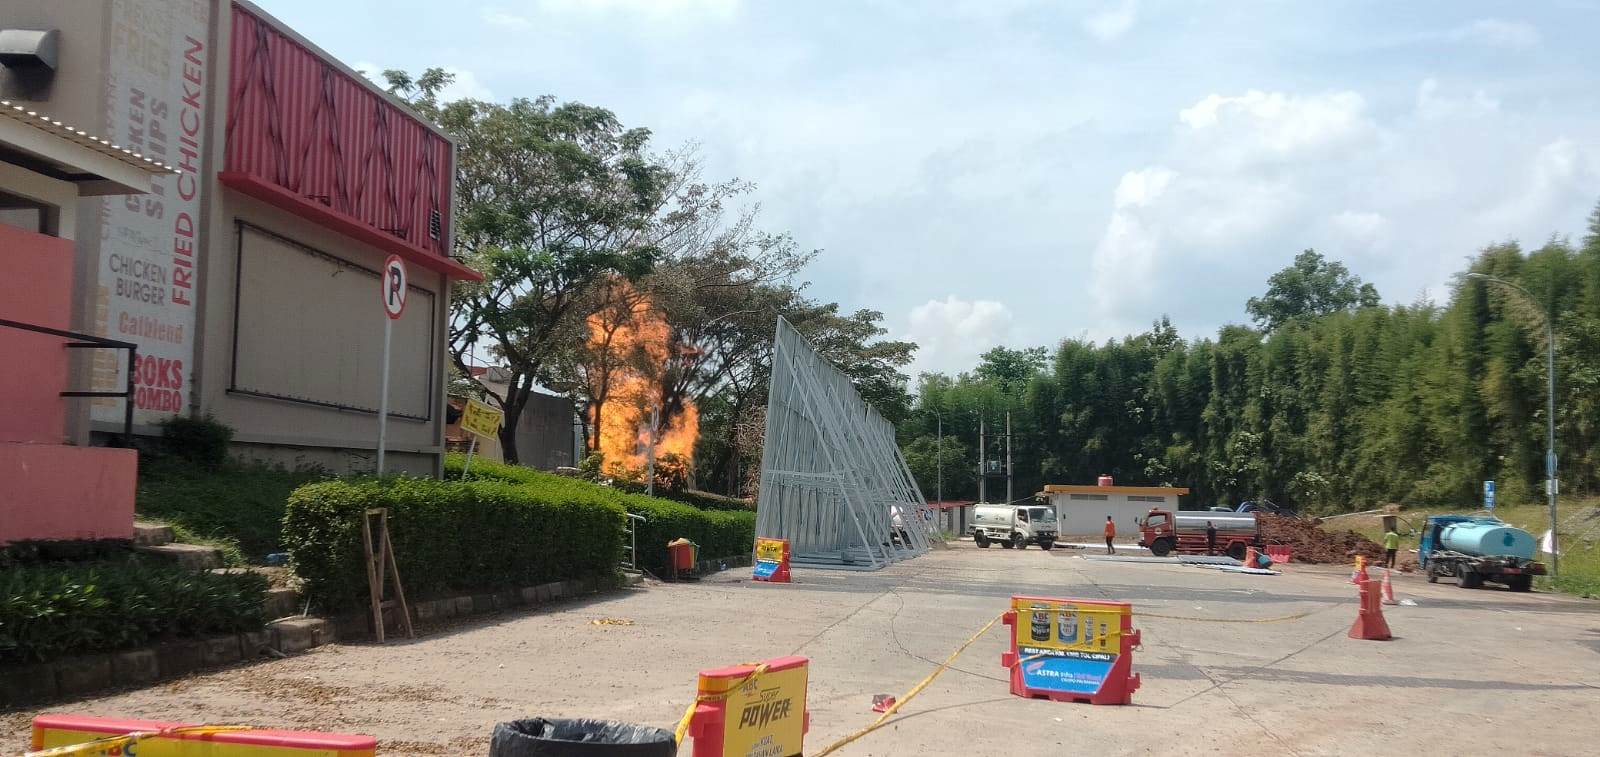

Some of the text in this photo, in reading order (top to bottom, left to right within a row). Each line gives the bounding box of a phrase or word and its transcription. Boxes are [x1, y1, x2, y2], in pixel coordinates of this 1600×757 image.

[177, 34, 204, 202] CHICKEN
[109, 253, 167, 285] CHICKEN
[171, 212, 194, 306] FRIED
[116, 277, 166, 306] BURGER
[134, 387, 182, 413] OMBO
[1037, 669, 1059, 677] ASTRA
[739, 698, 794, 731] POWER
